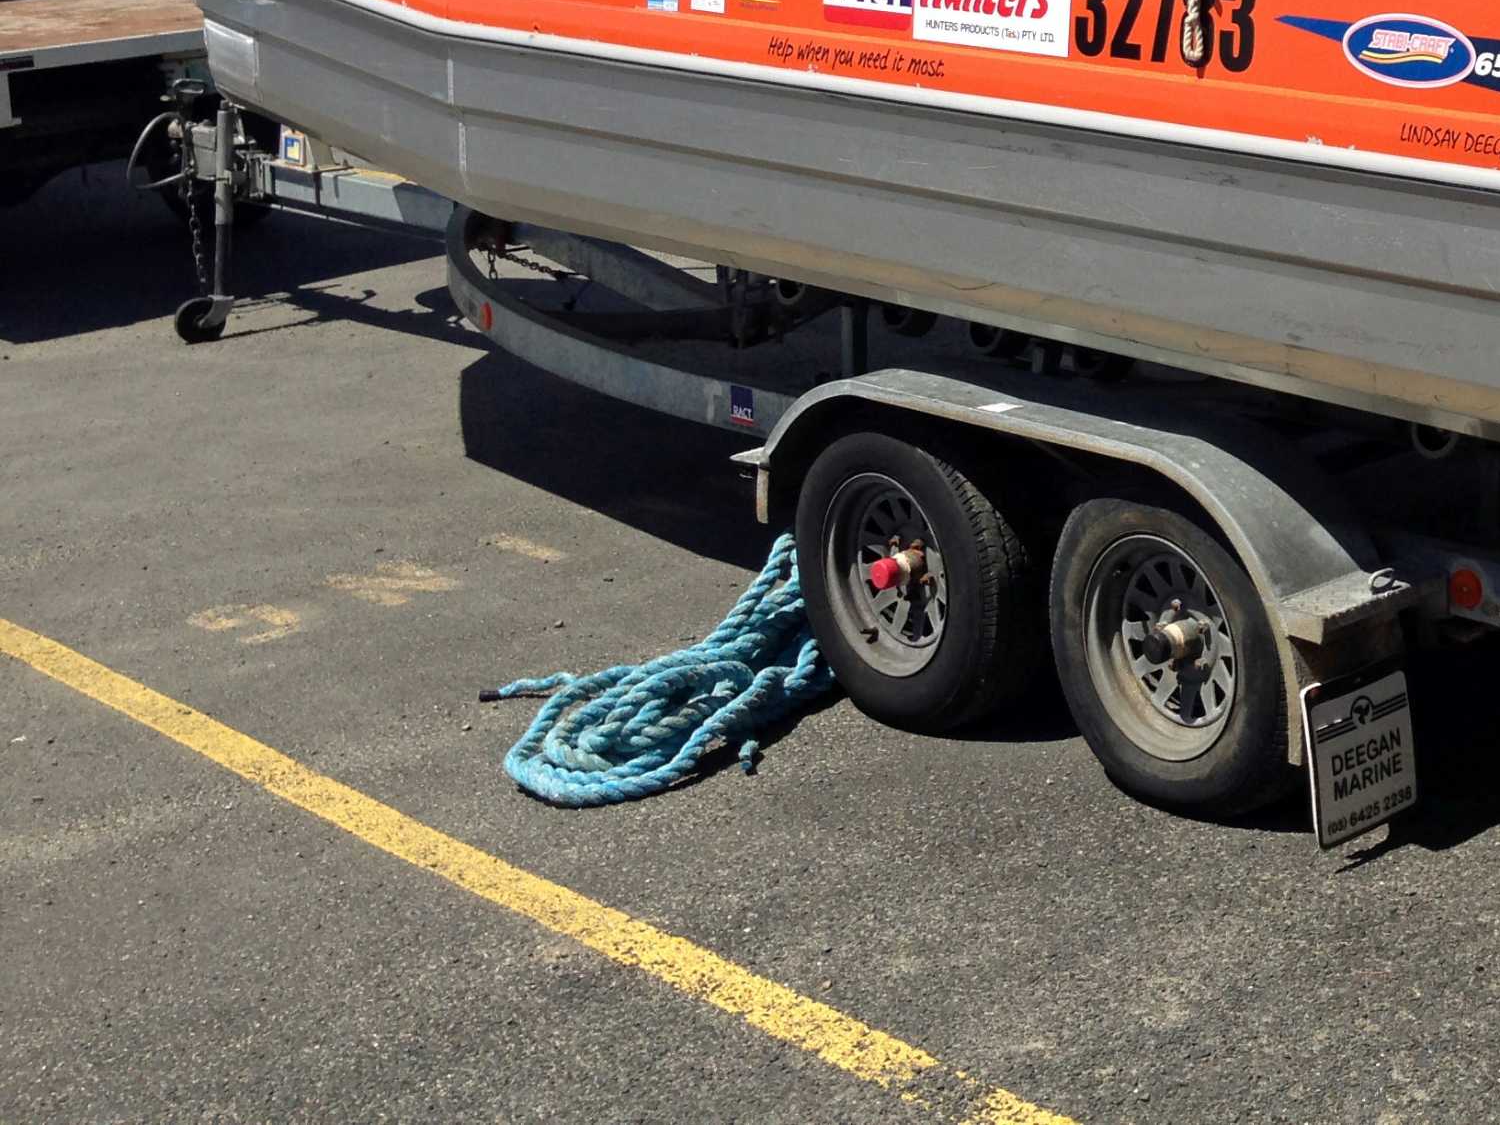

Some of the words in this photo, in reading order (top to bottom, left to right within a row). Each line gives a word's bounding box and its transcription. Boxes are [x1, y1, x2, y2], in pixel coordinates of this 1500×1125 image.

[926, 20, 959, 32] HUNTERS
[961, 23, 1000, 37] PRODUCTS
[1022, 30, 1037, 41] PTY
[768, 35, 793, 63] Help
[797, 38, 829, 62] when
[832, 49, 854, 70] you
[859, 48, 890, 71] need
[892, 50, 904, 72] it
[907, 57, 944, 77] most.
[1400, 123, 1461, 149] LINDSAY
[1331, 727, 1401, 776] DEEGAN
[1333, 753, 1403, 802] MARINE
[1349, 801, 1380, 827] 6425
